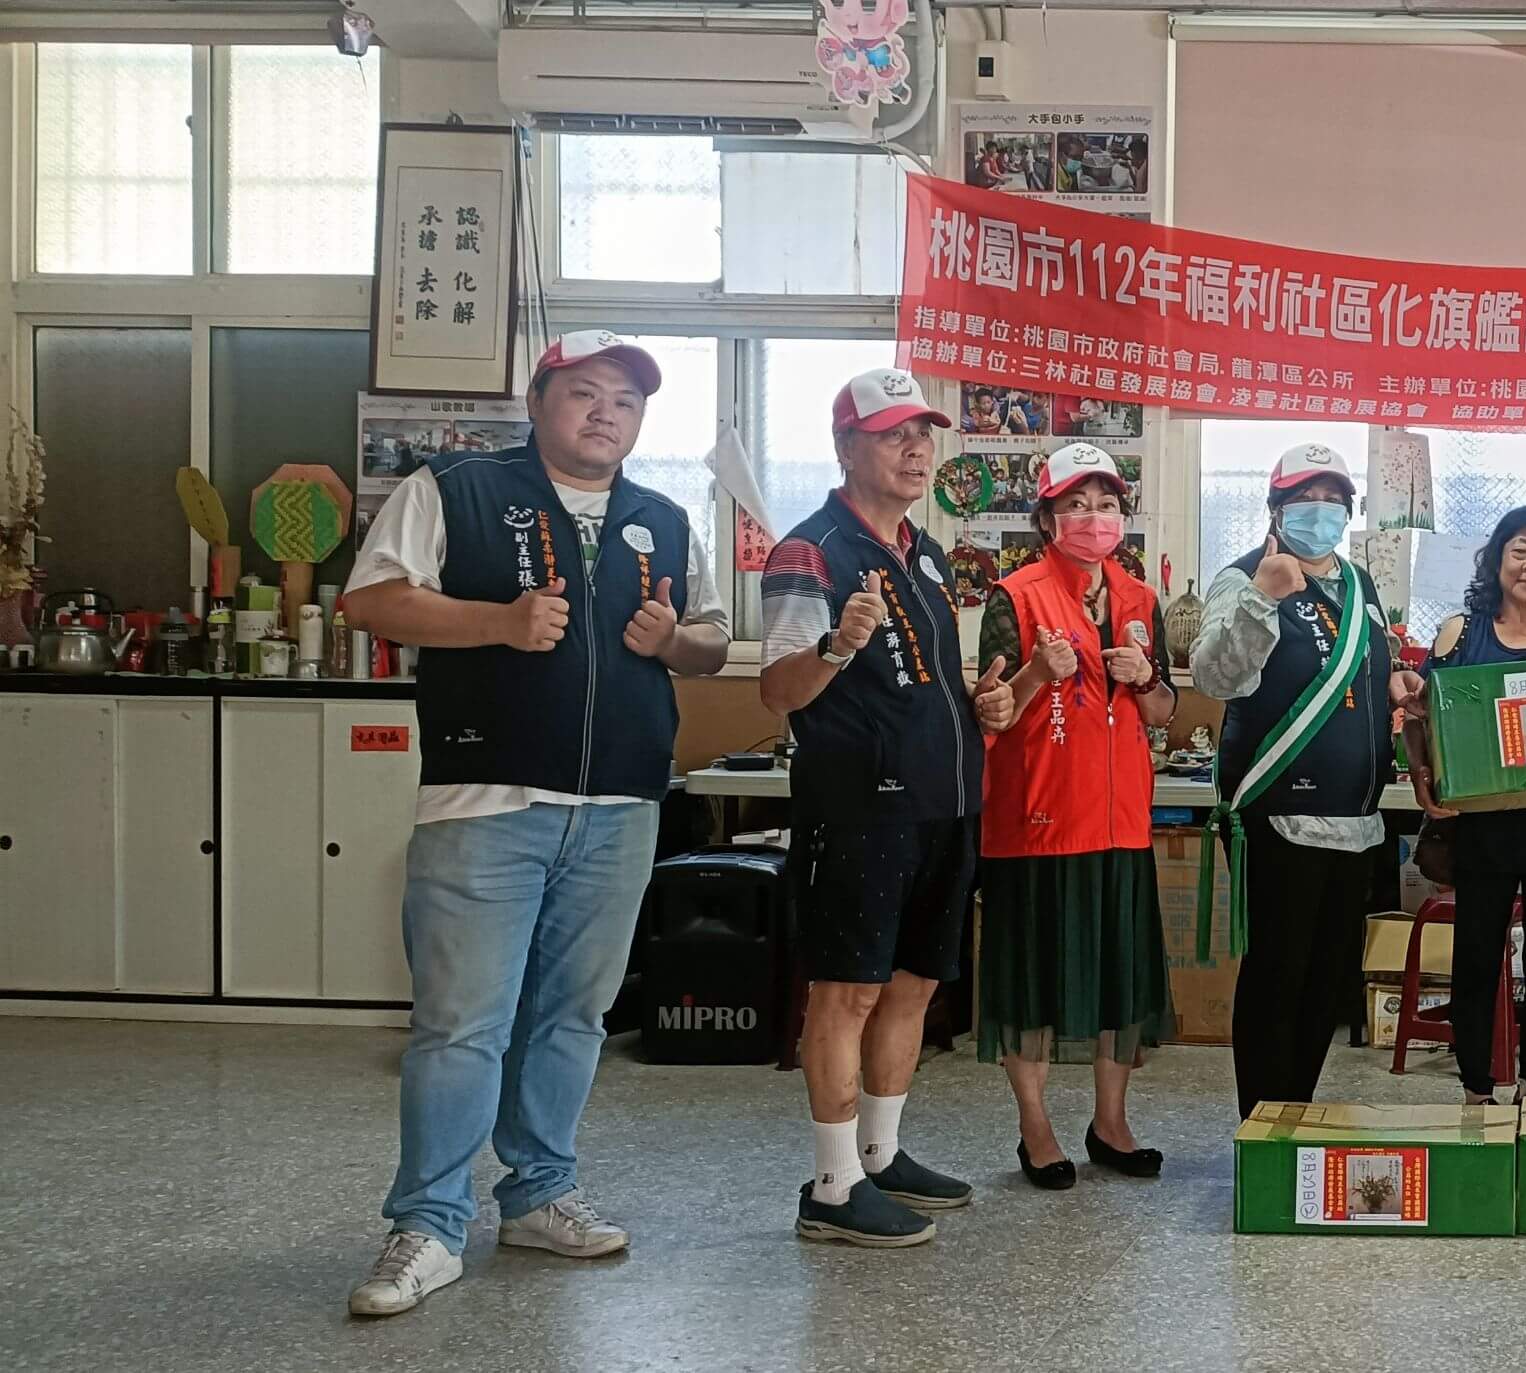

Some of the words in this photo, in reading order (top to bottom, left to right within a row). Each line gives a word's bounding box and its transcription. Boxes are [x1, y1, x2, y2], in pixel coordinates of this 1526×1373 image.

[1028, 113, 1085, 125] 大手包小手
[455, 206, 481, 254] 認識
[416, 267, 439, 321] 去除
[453, 271, 477, 325] 化解
[515, 531, 538, 592] 副主任張
[658, 994, 757, 1030] MIPRO
